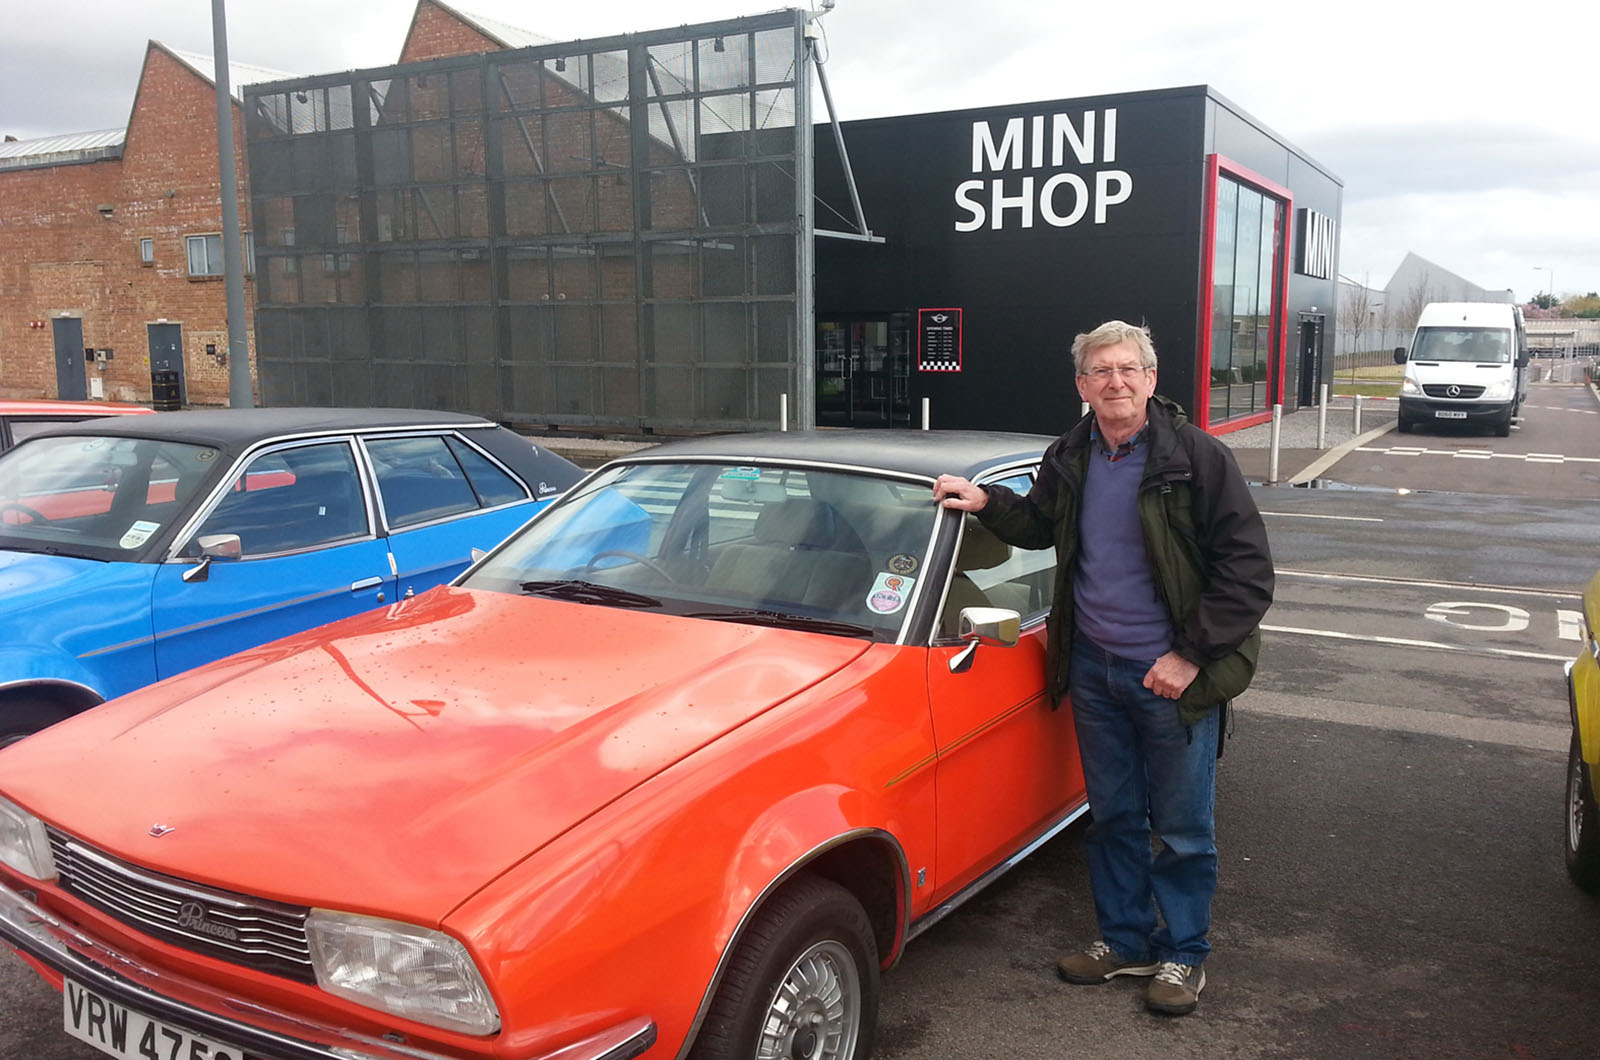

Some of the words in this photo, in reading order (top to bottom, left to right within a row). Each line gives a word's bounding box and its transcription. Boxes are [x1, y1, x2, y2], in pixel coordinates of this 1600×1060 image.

[972, 108, 1117, 173] MINI
[954, 170, 1133, 232] SHOP
[1304, 208, 1336, 281] MINI
[178, 902, 238, 940] Princess
[68, 983, 128, 1054] VRW
[139, 1021, 232, 1060] 475
